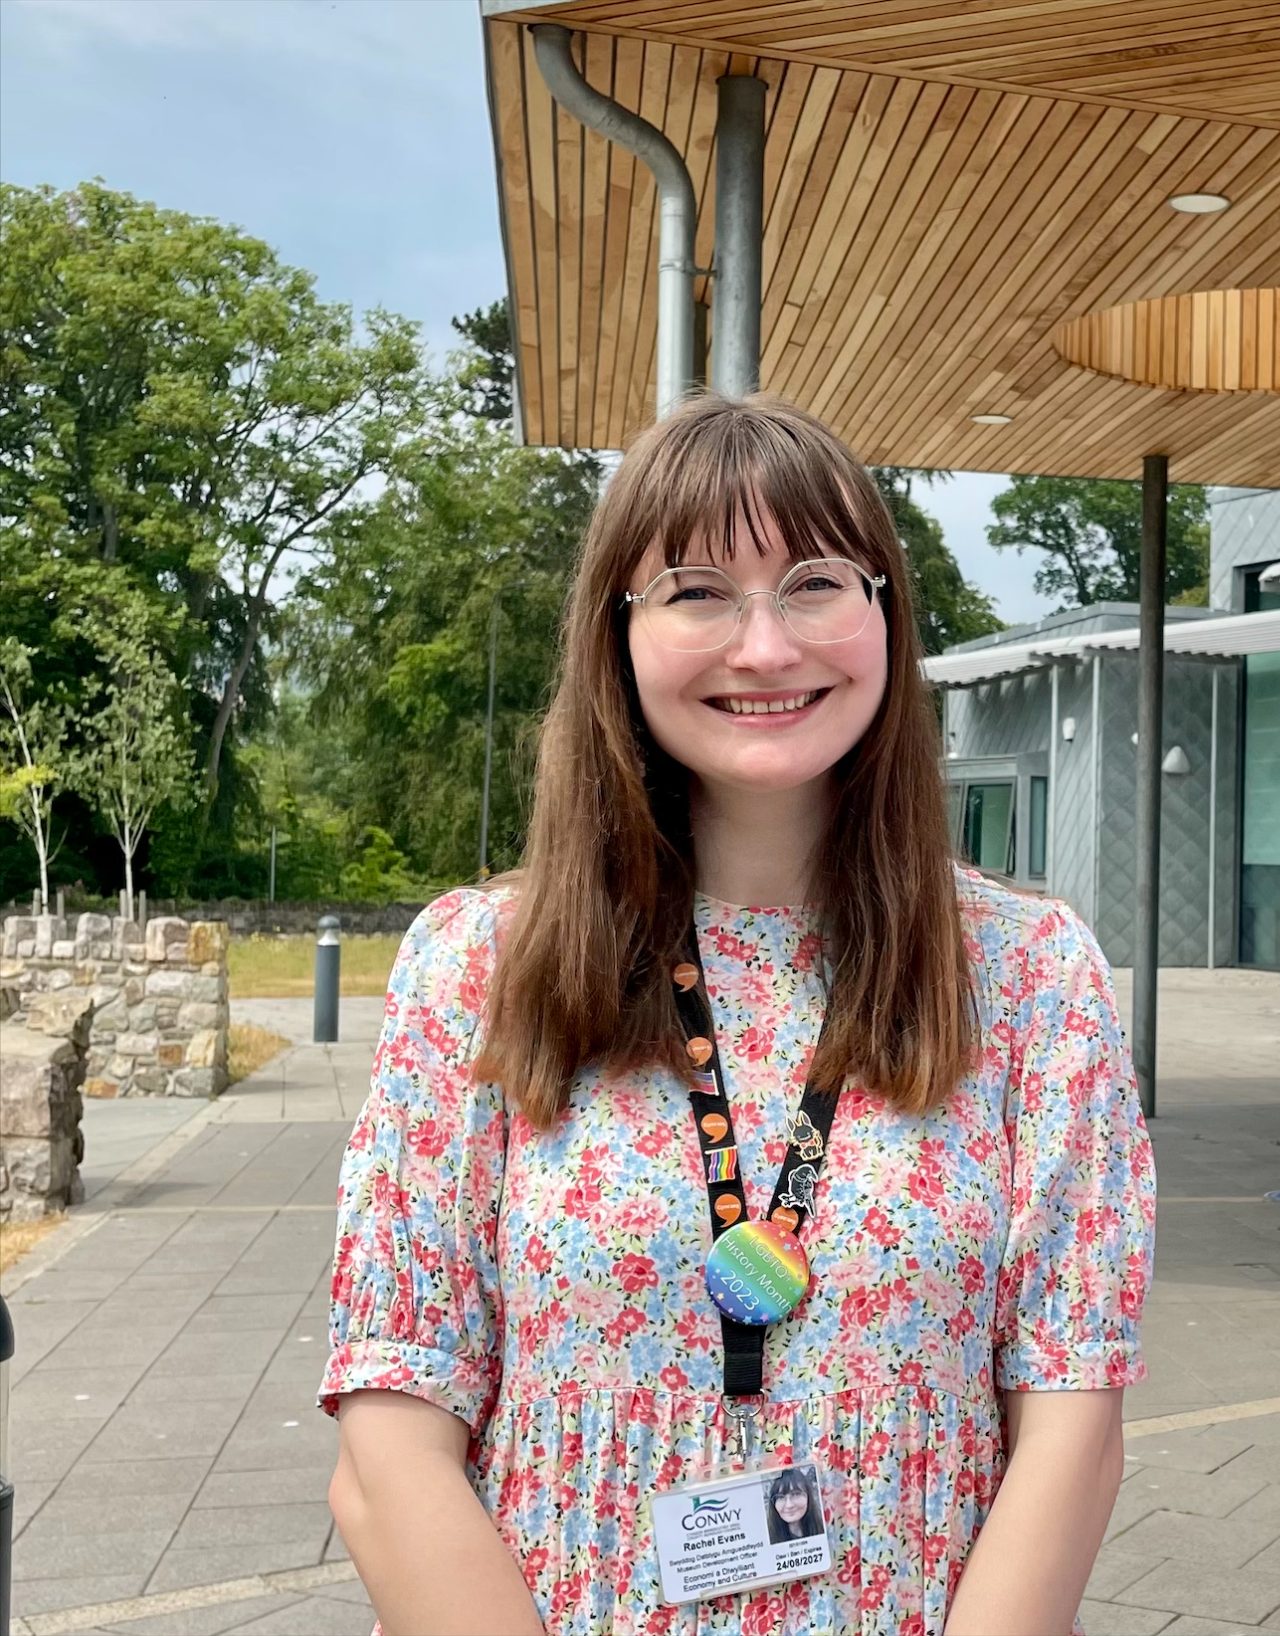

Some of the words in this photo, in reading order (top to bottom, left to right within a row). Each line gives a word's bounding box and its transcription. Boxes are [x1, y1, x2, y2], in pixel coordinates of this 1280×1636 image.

[721, 1235, 759, 1276] History
[757, 1274, 793, 1313] Month
[720, 1270, 759, 1310] 2023
[681, 1508, 741, 1530] CONWY
[683, 1538, 715, 1552] Rachel
[717, 1533, 746, 1545] Evans
[677, 1564, 701, 1573] Museum
[702, 1555, 739, 1568] Development
[740, 1552, 757, 1560] Officer
[776, 1553, 823, 1571] 24/08/2027
[683, 1581, 715, 1592] Economy
[717, 1575, 731, 1584] and
[732, 1571, 757, 1582] Culture
[684, 1571, 714, 1583] Economi
[722, 1563, 755, 1576] Diwylliant
